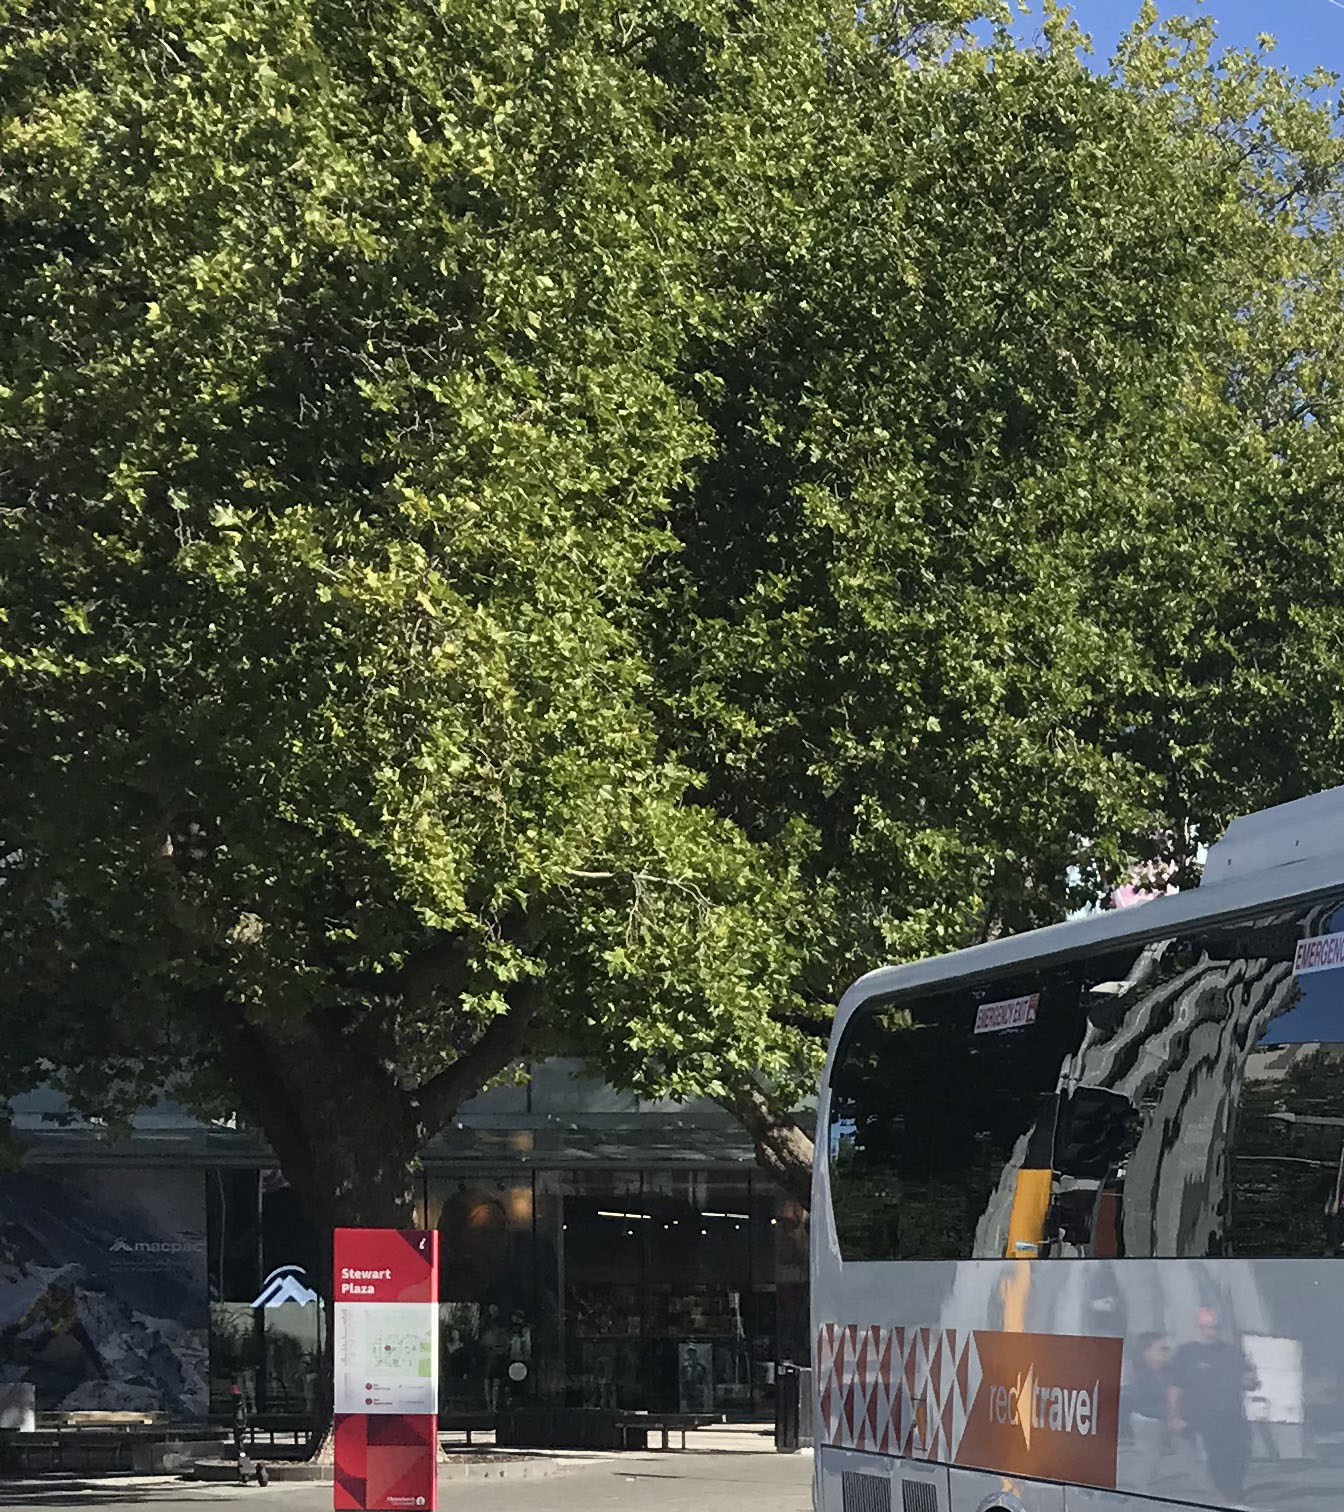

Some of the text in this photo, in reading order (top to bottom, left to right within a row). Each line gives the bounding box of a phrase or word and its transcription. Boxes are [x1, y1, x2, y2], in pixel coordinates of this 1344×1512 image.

[341, 1268, 391, 1280] Stewart
[341, 1282, 375, 1294] Plaza
[989, 1371, 1100, 1435] red travel
